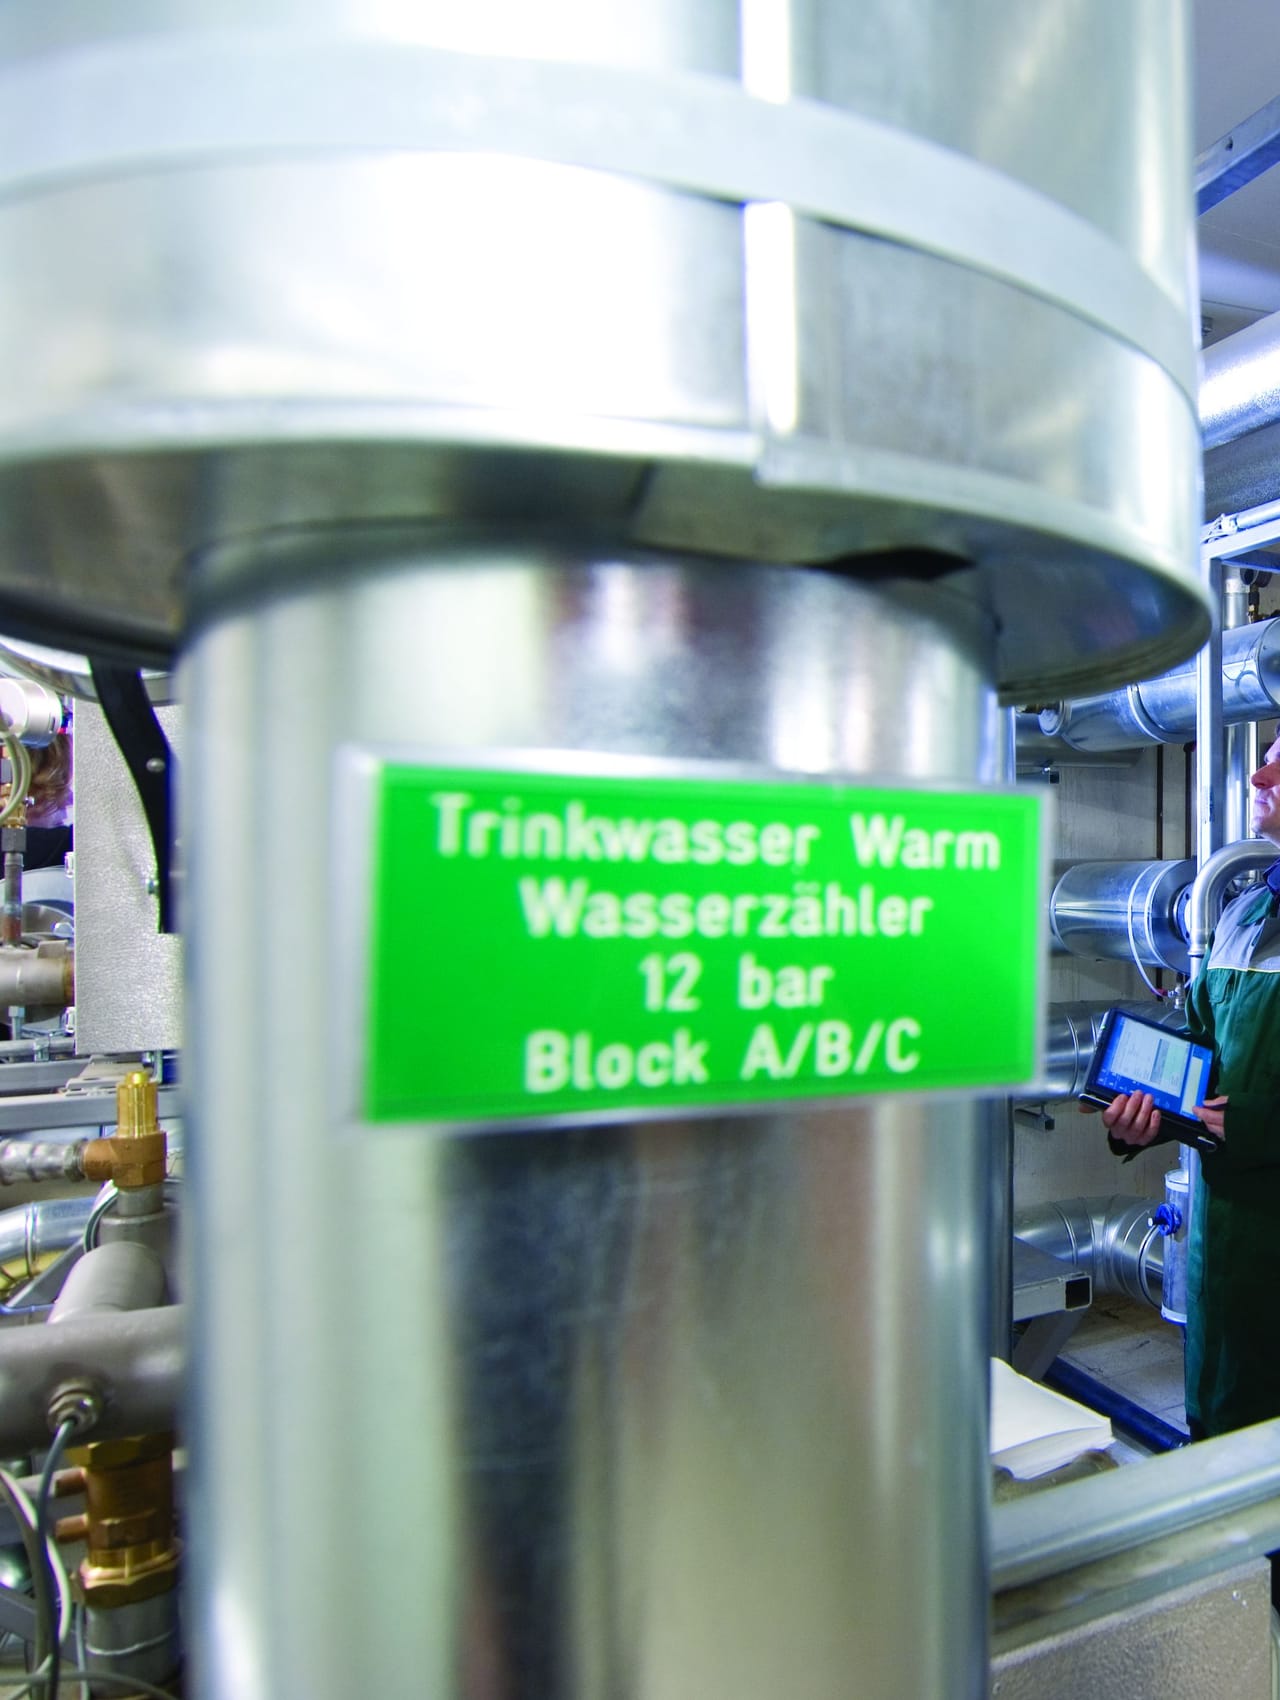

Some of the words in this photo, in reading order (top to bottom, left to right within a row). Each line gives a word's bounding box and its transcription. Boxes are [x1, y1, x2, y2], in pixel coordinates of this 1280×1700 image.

[430, 792, 820, 866] Trinkwasser
[849, 812, 1002, 870] Warm
[519, 876, 934, 938] Wasserzähler
[640, 952, 703, 1011] 12
[738, 953, 834, 1009] bar
[524, 1029, 708, 1093] Block
[740, 1016, 921, 1077] A/B/C
